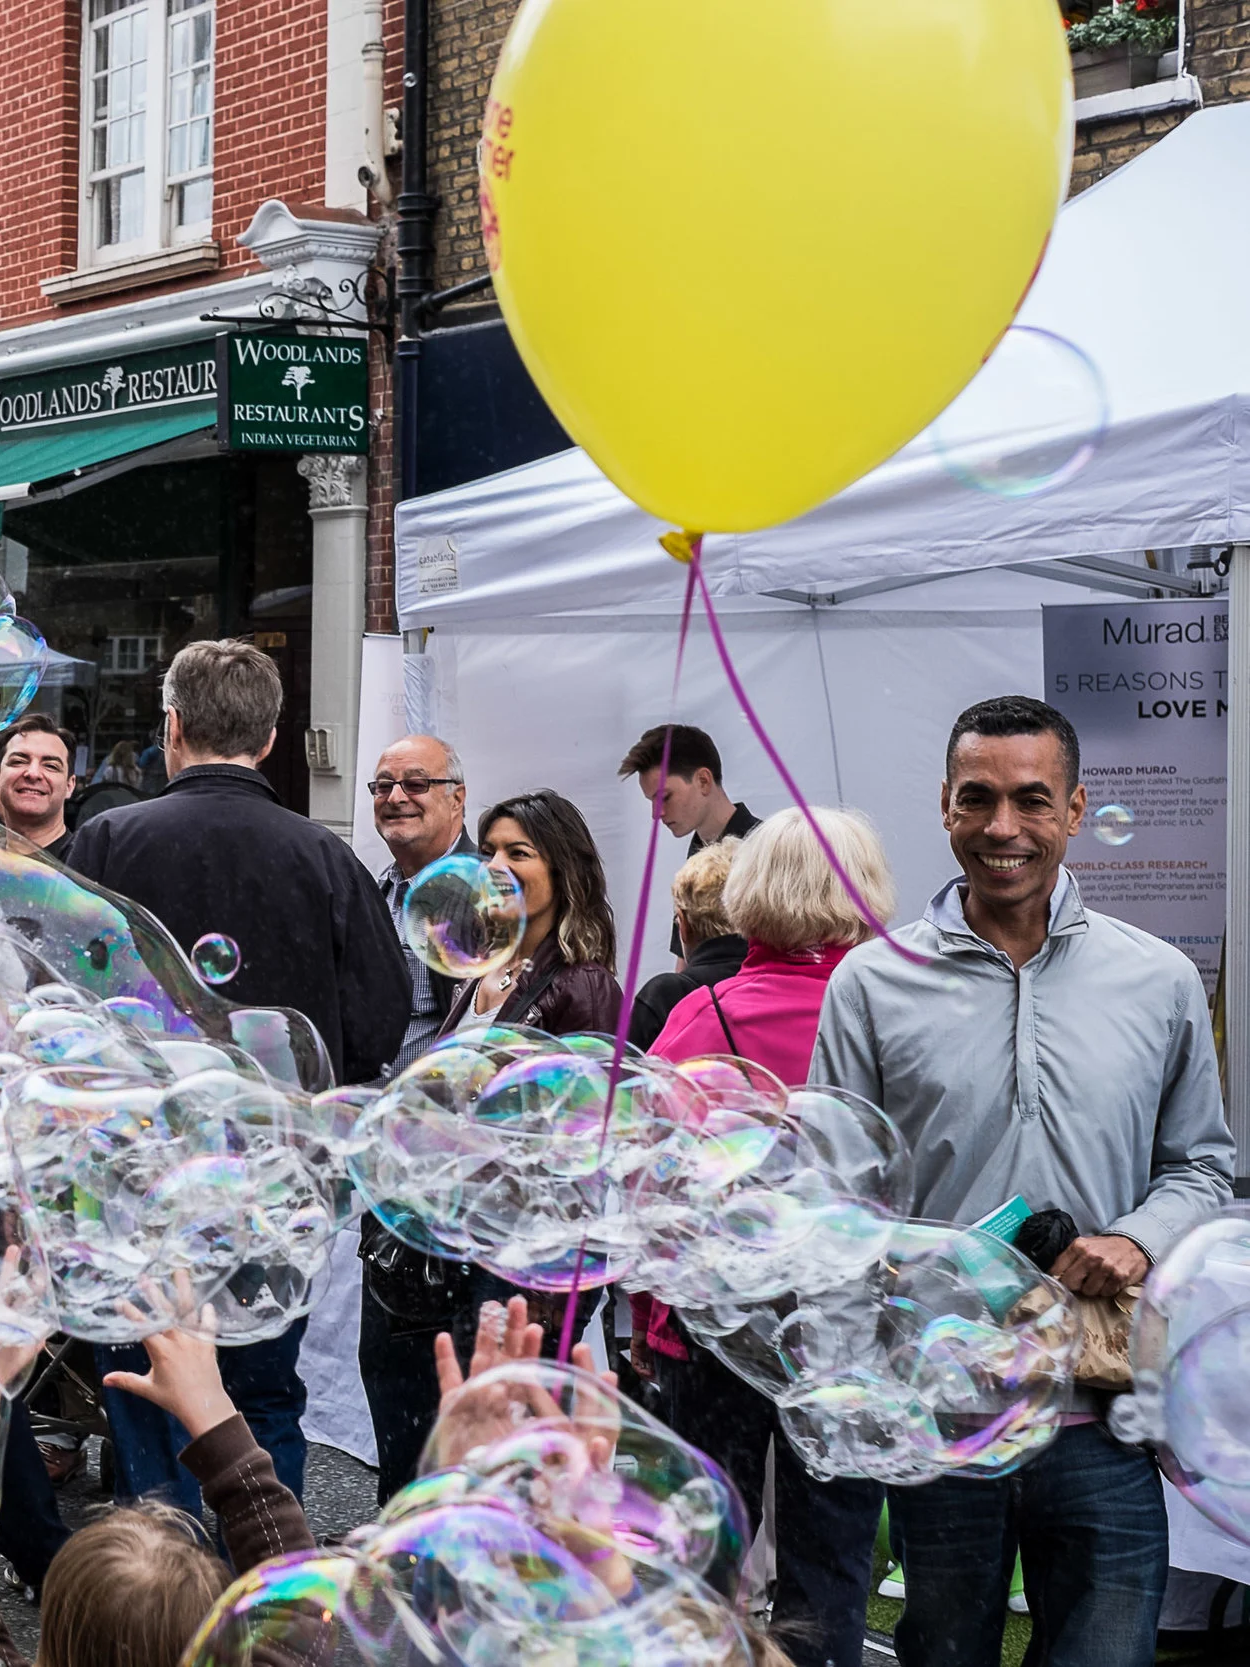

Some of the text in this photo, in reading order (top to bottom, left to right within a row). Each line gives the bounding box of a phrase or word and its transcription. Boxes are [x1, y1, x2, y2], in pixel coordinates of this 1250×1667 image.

[234, 337, 362, 366] WOODLANDS
[234, 404, 365, 432] RESTAURANTS
[241, 432, 358, 447] INDIAN VEGETARIAN
[1103, 615, 1206, 645] Murad
[1055, 674, 1069, 693] 5
[1078, 671, 1204, 692] REASONS
[1137, 700, 1207, 719] LOVE
[1082, 765, 1177, 777] HOWARD MURAD
[1148, 860, 1208, 870] RESEARCH
[1179, 935, 1224, 945] RESULT
